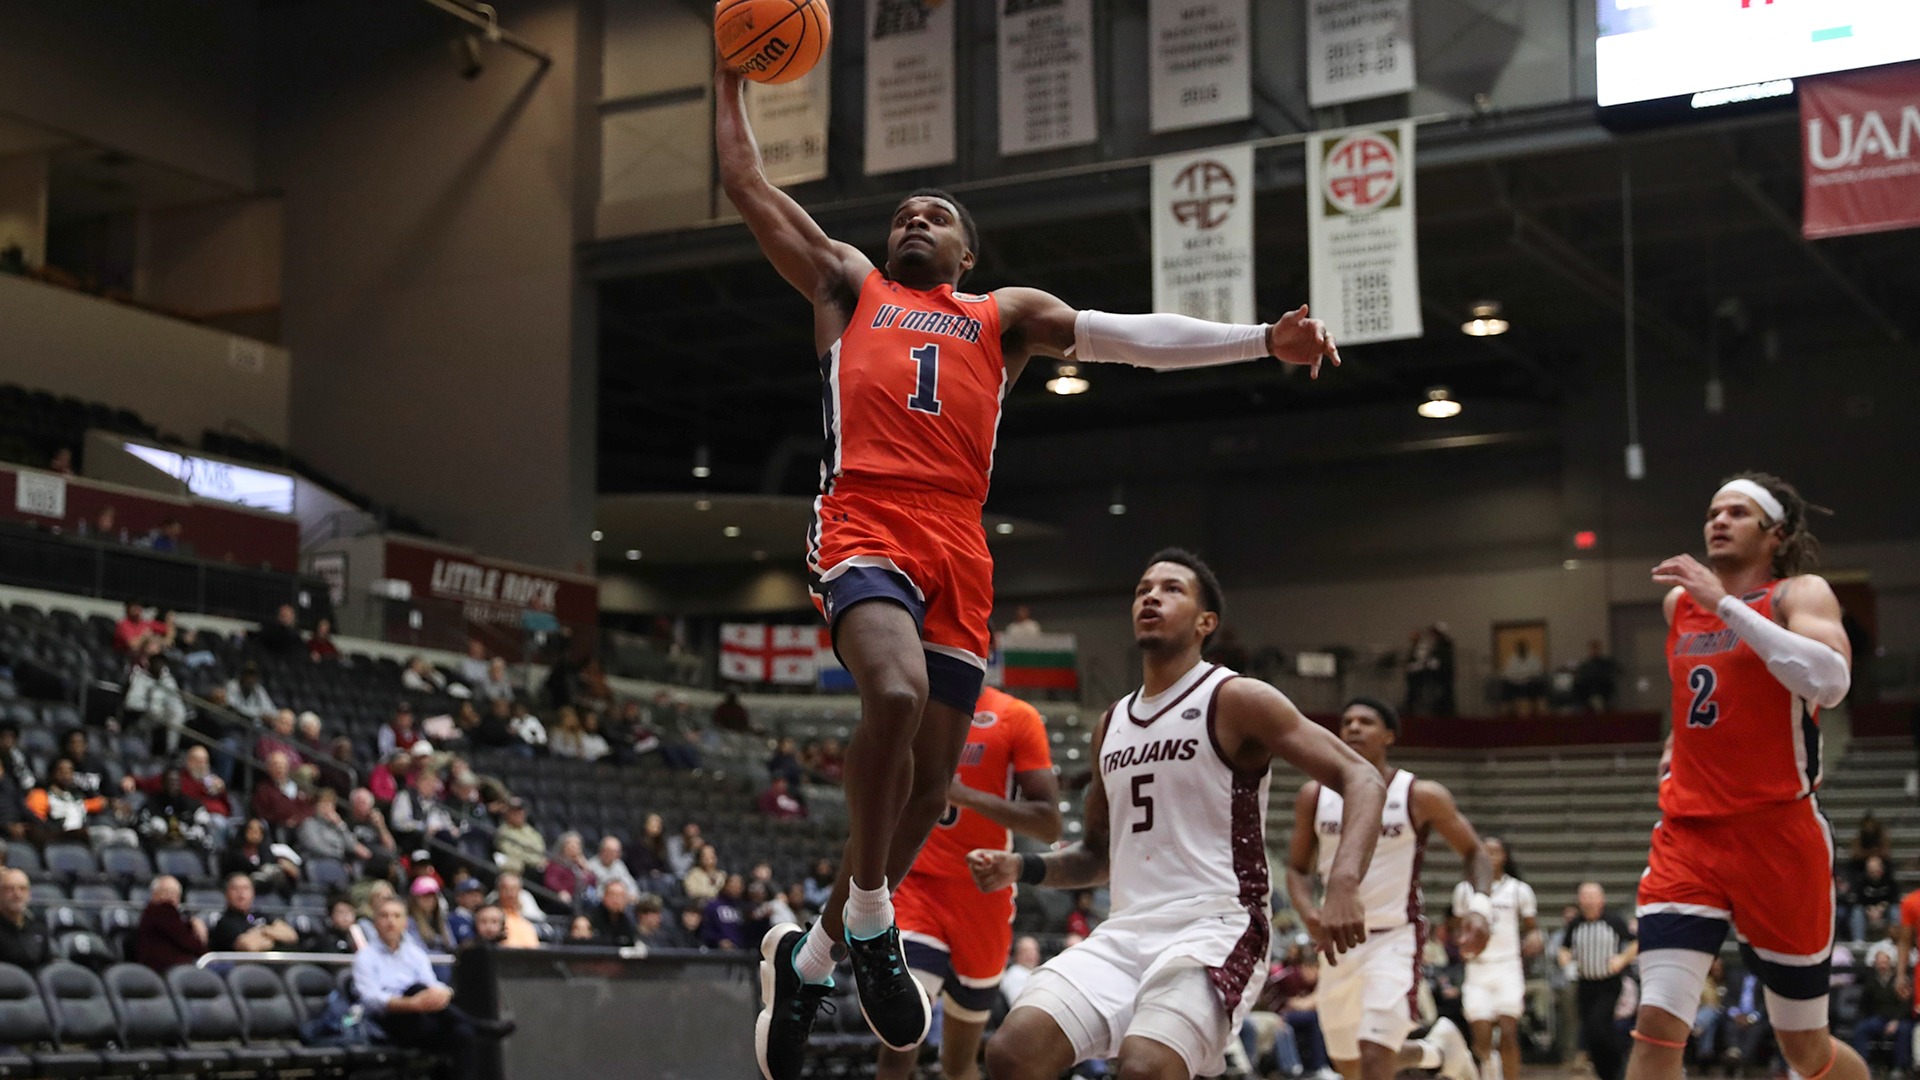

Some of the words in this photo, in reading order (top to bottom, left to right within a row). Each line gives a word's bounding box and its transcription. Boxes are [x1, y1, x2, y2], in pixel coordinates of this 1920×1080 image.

[739, 37, 790, 74] Wilso
[871, 303, 906, 329] UT
[899, 309, 983, 344] MARTIN
[907, 342, 942, 416] 1
[430, 558, 501, 599] LITTLE
[1686, 663, 1719, 729] 2
[1103, 738, 1199, 776] TROJANS
[1131, 773, 1154, 833] 5
